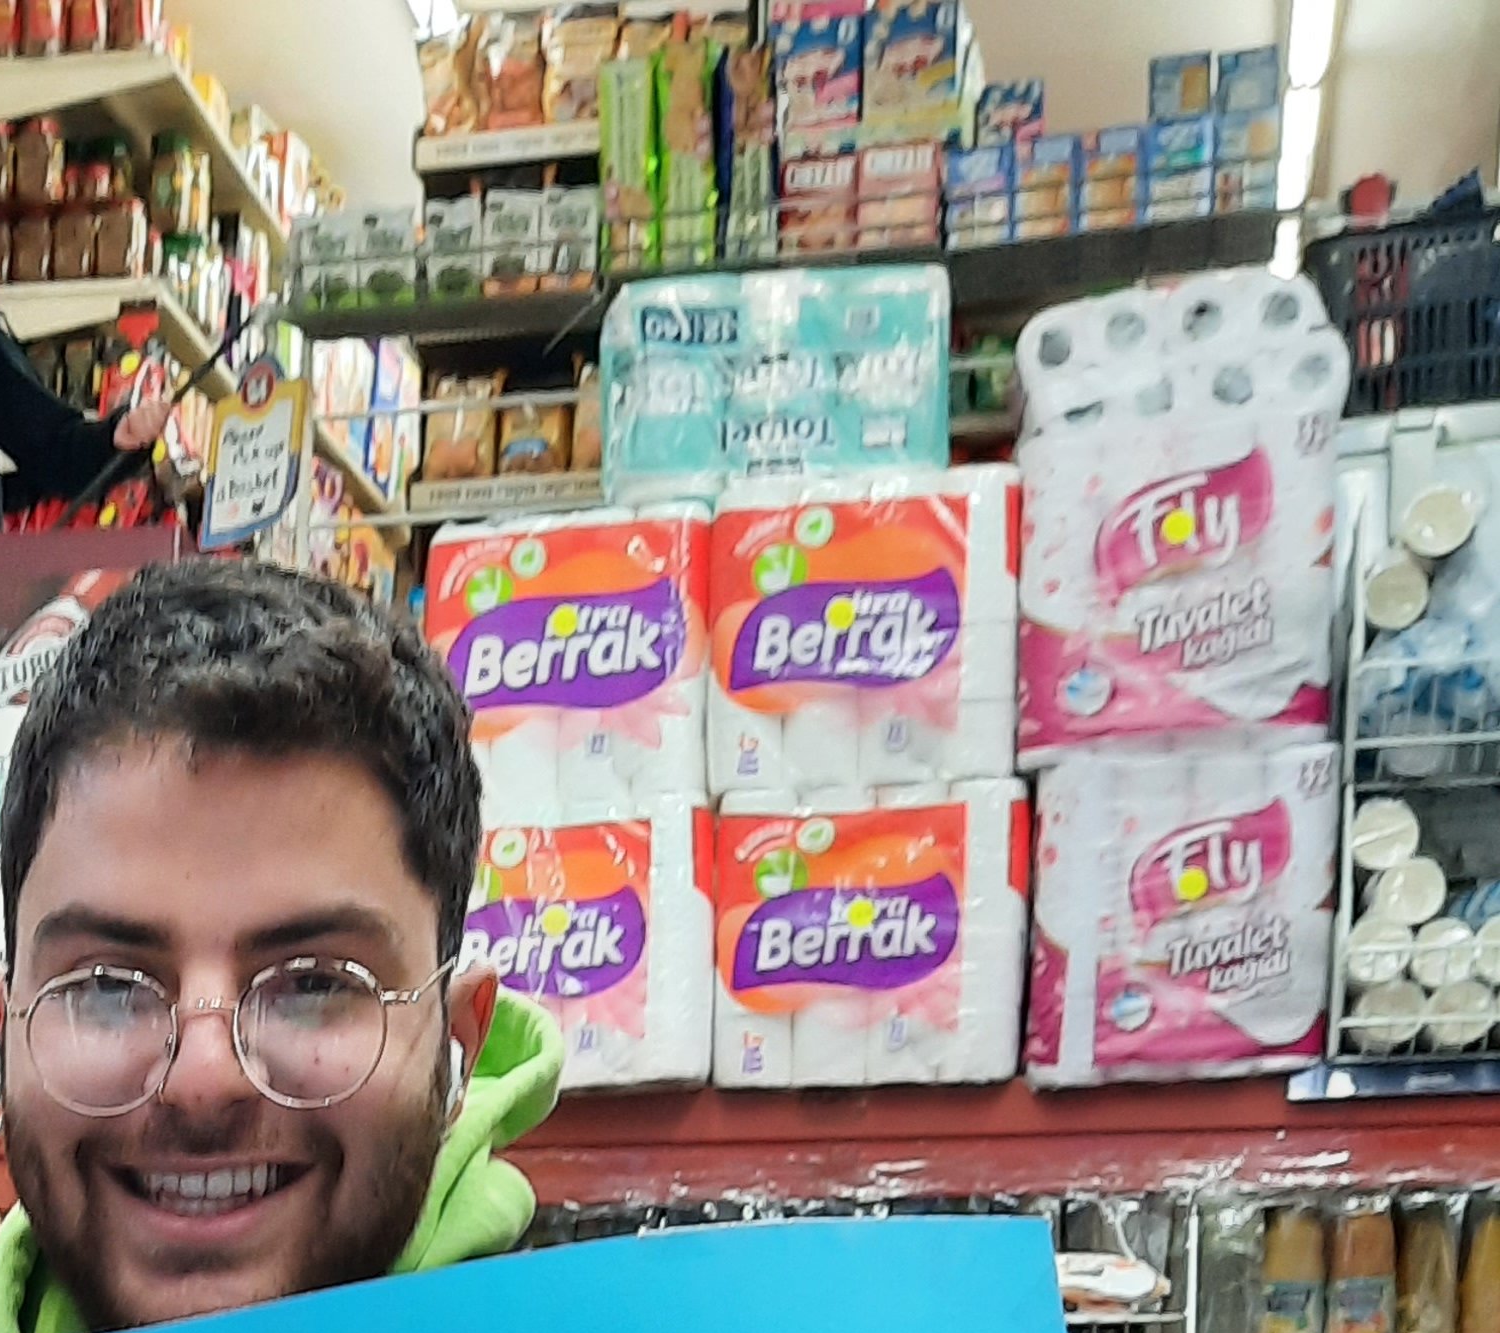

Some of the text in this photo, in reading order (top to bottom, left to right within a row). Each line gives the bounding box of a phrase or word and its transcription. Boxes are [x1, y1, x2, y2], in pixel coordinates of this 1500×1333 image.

[464, 609, 664, 695] Berrak
[753, 603, 940, 675] Berrak
[757, 904, 937, 972] Berrak
